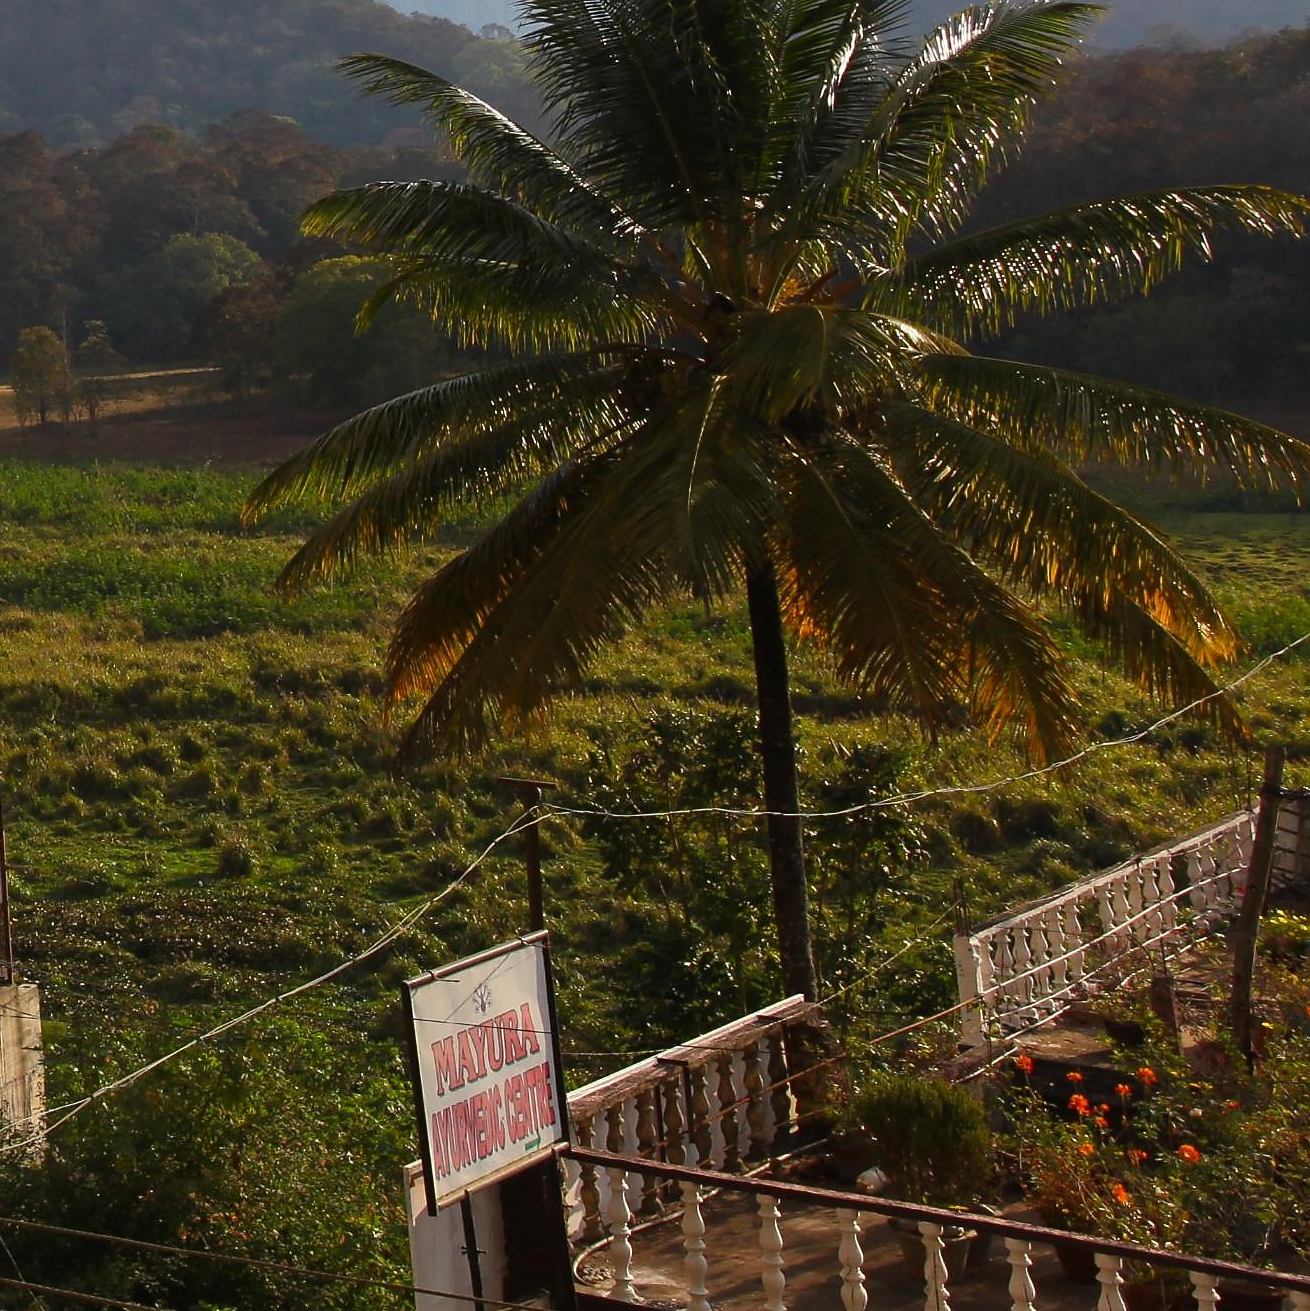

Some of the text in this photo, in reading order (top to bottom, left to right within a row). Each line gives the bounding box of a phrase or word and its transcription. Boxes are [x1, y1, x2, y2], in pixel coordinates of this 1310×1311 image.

[431, 1002, 539, 1096] MAYURA
[432, 1062, 556, 1179] AYURVEDIC CENTRE
